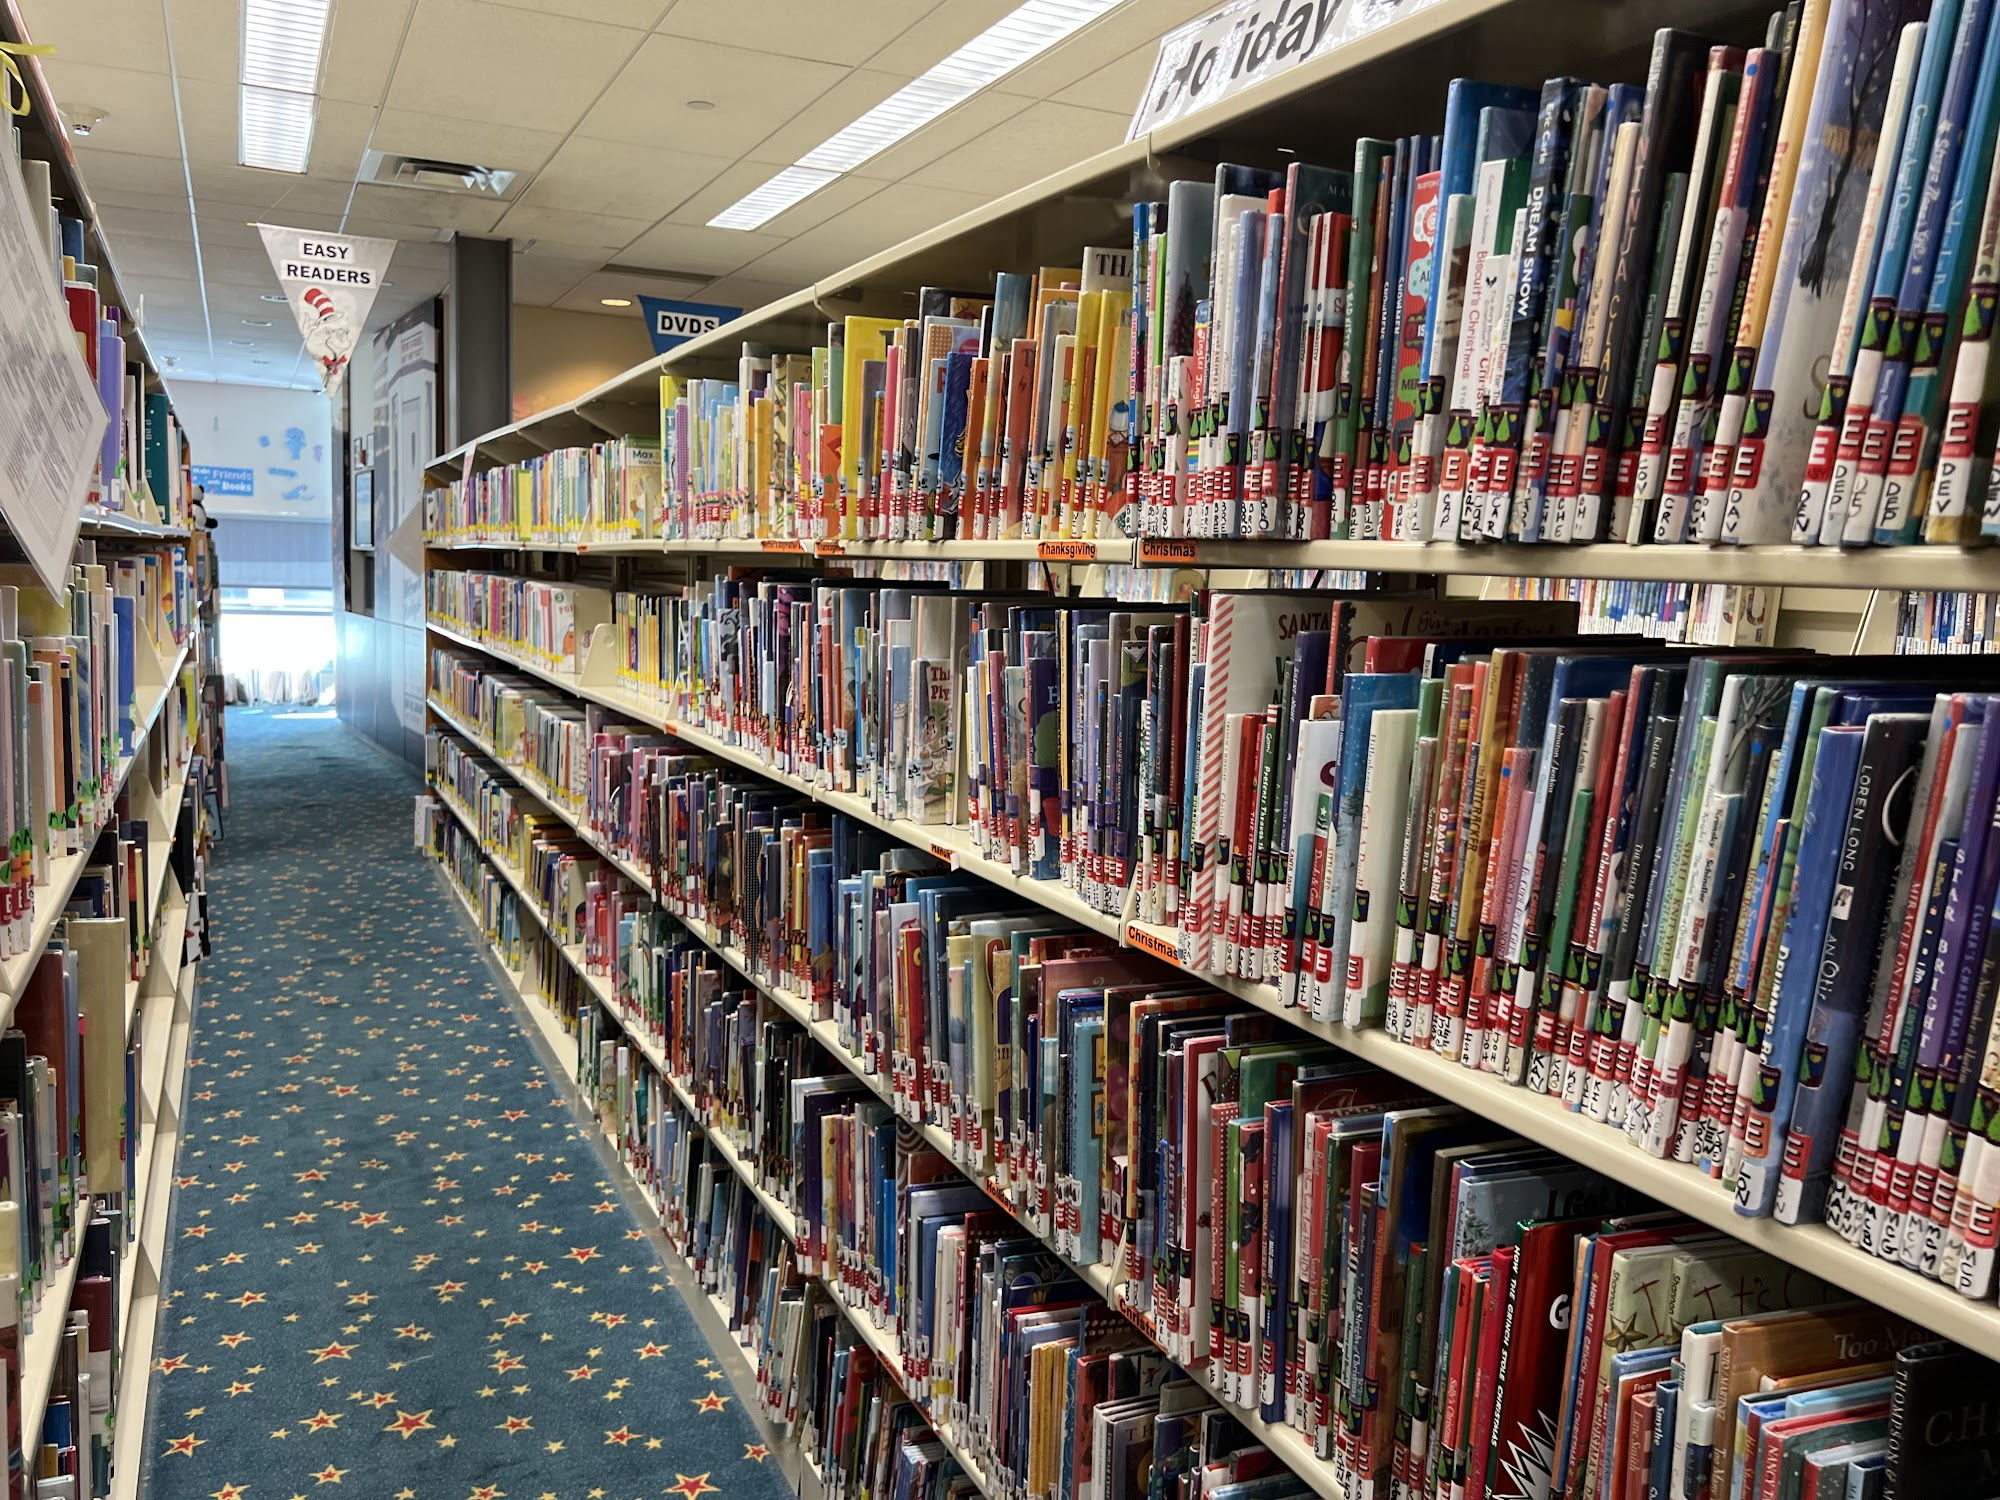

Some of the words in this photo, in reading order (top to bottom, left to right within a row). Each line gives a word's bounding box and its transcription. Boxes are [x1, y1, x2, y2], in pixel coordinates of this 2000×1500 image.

[1154, 0, 1344, 114] Hoiday
[1543, 102, 1555, 129] Eric
[1539, 132, 1550, 165] Carle
[1525, 186, 1544, 253] DREAM
[303, 243, 349, 259] EASY
[287, 264, 371, 284] READERS
[1471, 251, 1489, 306] Biscuit's
[1517, 258, 1535, 317] SNOW
[661, 315, 716, 334] DVDS
[1500, 294, 1515, 341] Christmas
[1587, 304, 1599, 331] Best
[1461, 310, 1480, 380] Christmas
[1497, 343, 1508, 372] Cheer
[1495, 374, 1503, 388] for
[632, 450, 654, 459] Max
[212, 470, 252, 480] Friends
[222, 480, 252, 491] Books
[1039, 542, 1096, 559] Thanksgiving
[1142, 543, 1195, 558] Christmas
[1278, 612, 1329, 640] SANTA
[1649, 736, 1663, 769] KILLEN
[1261, 765, 1270, 804] Presents
[1853, 764, 1873, 820] LOREN
[1258, 806, 1267, 840] Through
[1467, 777, 1486, 852] NUTCRACKER
[1434, 824, 1447, 853] DAYS
[1601, 815, 1616, 848] Santa
[1287, 849, 1295, 872] SANTA
[1325, 848, 1333, 875] LITTLE
[1490, 838, 1500, 858] Bea
[1634, 843, 1644, 861] THE
[1675, 841, 1692, 884] SHALL
[1843, 827, 1861, 871] LONG
[1488, 860, 1496, 873] in
[1596, 851, 1612, 885] Claus
[1629, 861, 1641, 890] LITTLE
[1698, 858, 1714, 904] Schindler
[1483, 875, 1493, 896] The
[1620, 892, 1635, 934] REINDEER
[1665, 898, 1681, 931] KNIT
[1898, 880, 1921, 950] MIRACLE
[1128, 926, 1179, 960] Christmas
[1691, 916, 1704, 944] How
[1825, 934, 1837, 956] AN
[1964, 904, 1985, 961] ELMER'S
[1661, 934, 1674, 962] YOU
[1684, 945, 1700, 980] Santa
[1892, 953, 1908, 976] ON
[1764, 944, 1790, 1035] DRUMMER
[1947, 966, 1972, 1046] CHRISTMAS
[1375, 1235, 1384, 1255] THAT
[1512, 1245, 1521, 1274] HOW
[1372, 1256, 1382, 1300] CHRISTMAS
[1508, 1279, 1518, 1300] THE
[1609, 1270, 1621, 1312] Shannon
[1587, 1281, 1599, 1309] HOW
[1668, 1274, 1681, 1316] Shannon
[1353, 1313, 1362, 1345] Sleighs
[1502, 1303, 1515, 1345] GRINCH
[1585, 1313, 1594, 1332] THE
[1578, 1336, 1591, 1374] GRINCH
[1722, 1346, 1731, 1371] SOTO
[1834, 1334, 1877, 1360] Too
[1351, 1354, 1361, 1398] Christmas
[1498, 1349, 1508, 1381] STOLE
[1448, 1377, 1457, 1405] Sally's
[1575, 1377, 1585, 1407] STOLE
[1633, 1383, 1652, 1393] From
[1717, 1377, 1731, 1421] MARTINEZ
[1490, 1385, 1504, 1448] CHRISTMAS
[1633, 1411, 1643, 1438] Lane
[1654, 1405, 1665, 1446] Smythe
[1893, 1369, 1909, 1465] THOMPSON
[1567, 1411, 1581, 1466] CHRISTMAS
[1629, 1439, 1641, 1472] Smith
[1764, 1444, 1779, 1473] NANCY
